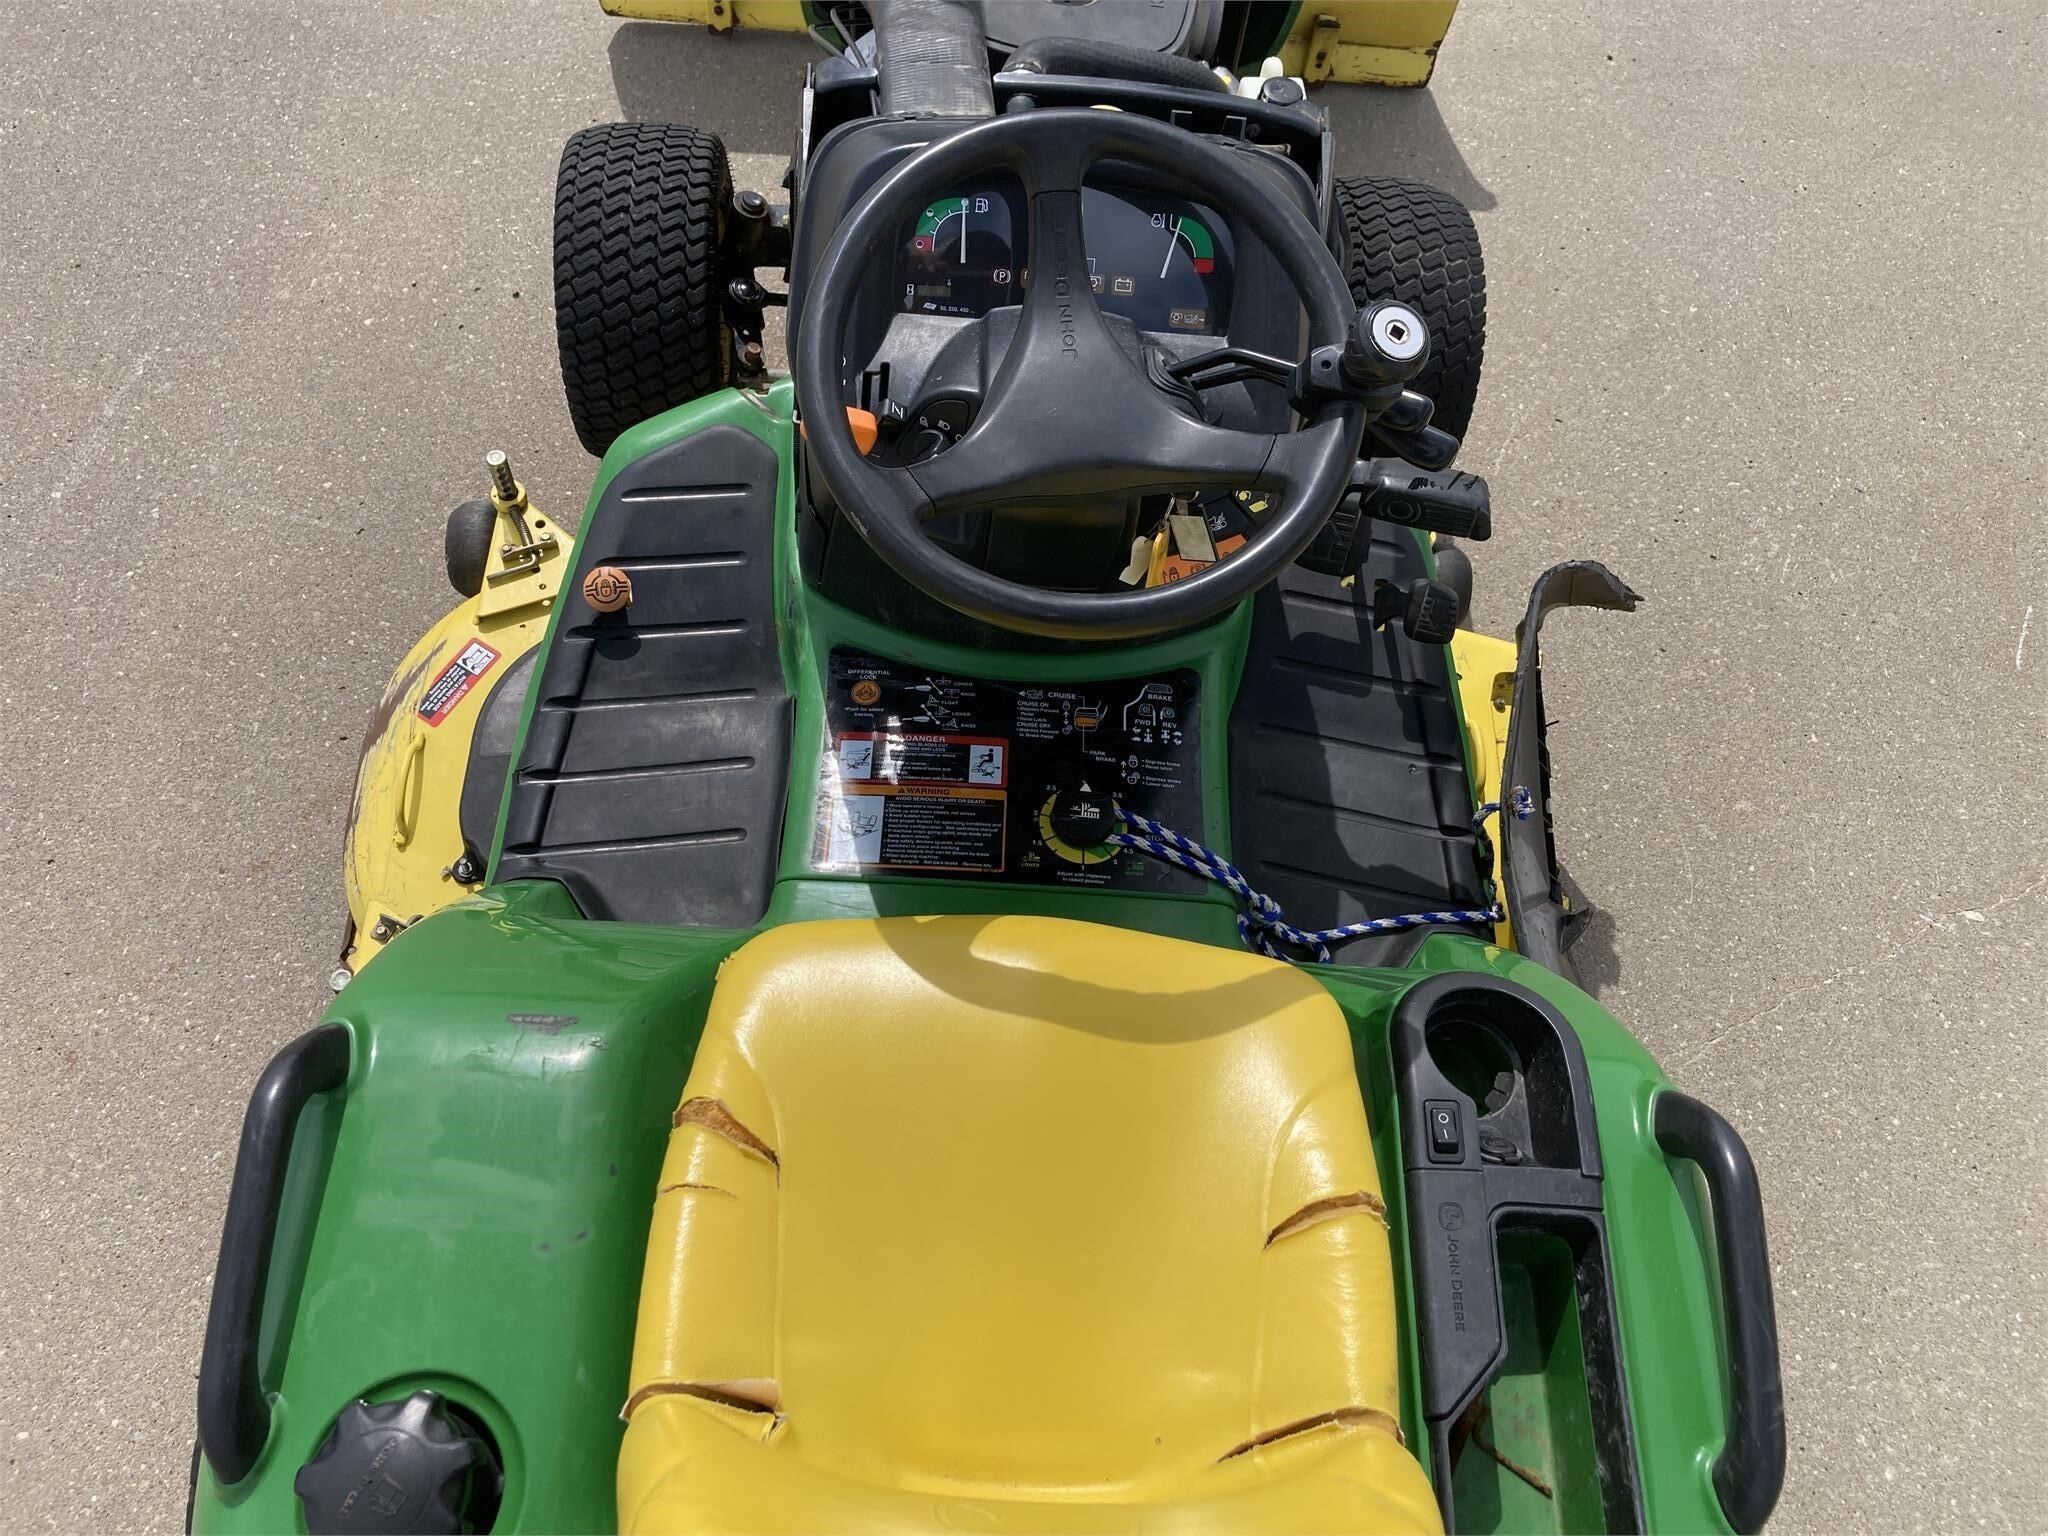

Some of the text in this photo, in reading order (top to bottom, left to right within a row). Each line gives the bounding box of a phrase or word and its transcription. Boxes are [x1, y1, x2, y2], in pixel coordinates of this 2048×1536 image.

[1059, 303, 1079, 361] JOHN
[892, 402, 904, 419] N
[441, 690, 465, 715] DANGER
[1048, 692, 1077, 700] CRUISE
[905, 735, 946, 743] DANGER
[1447, 1234, 1465, 1333] JOHN DEERE
